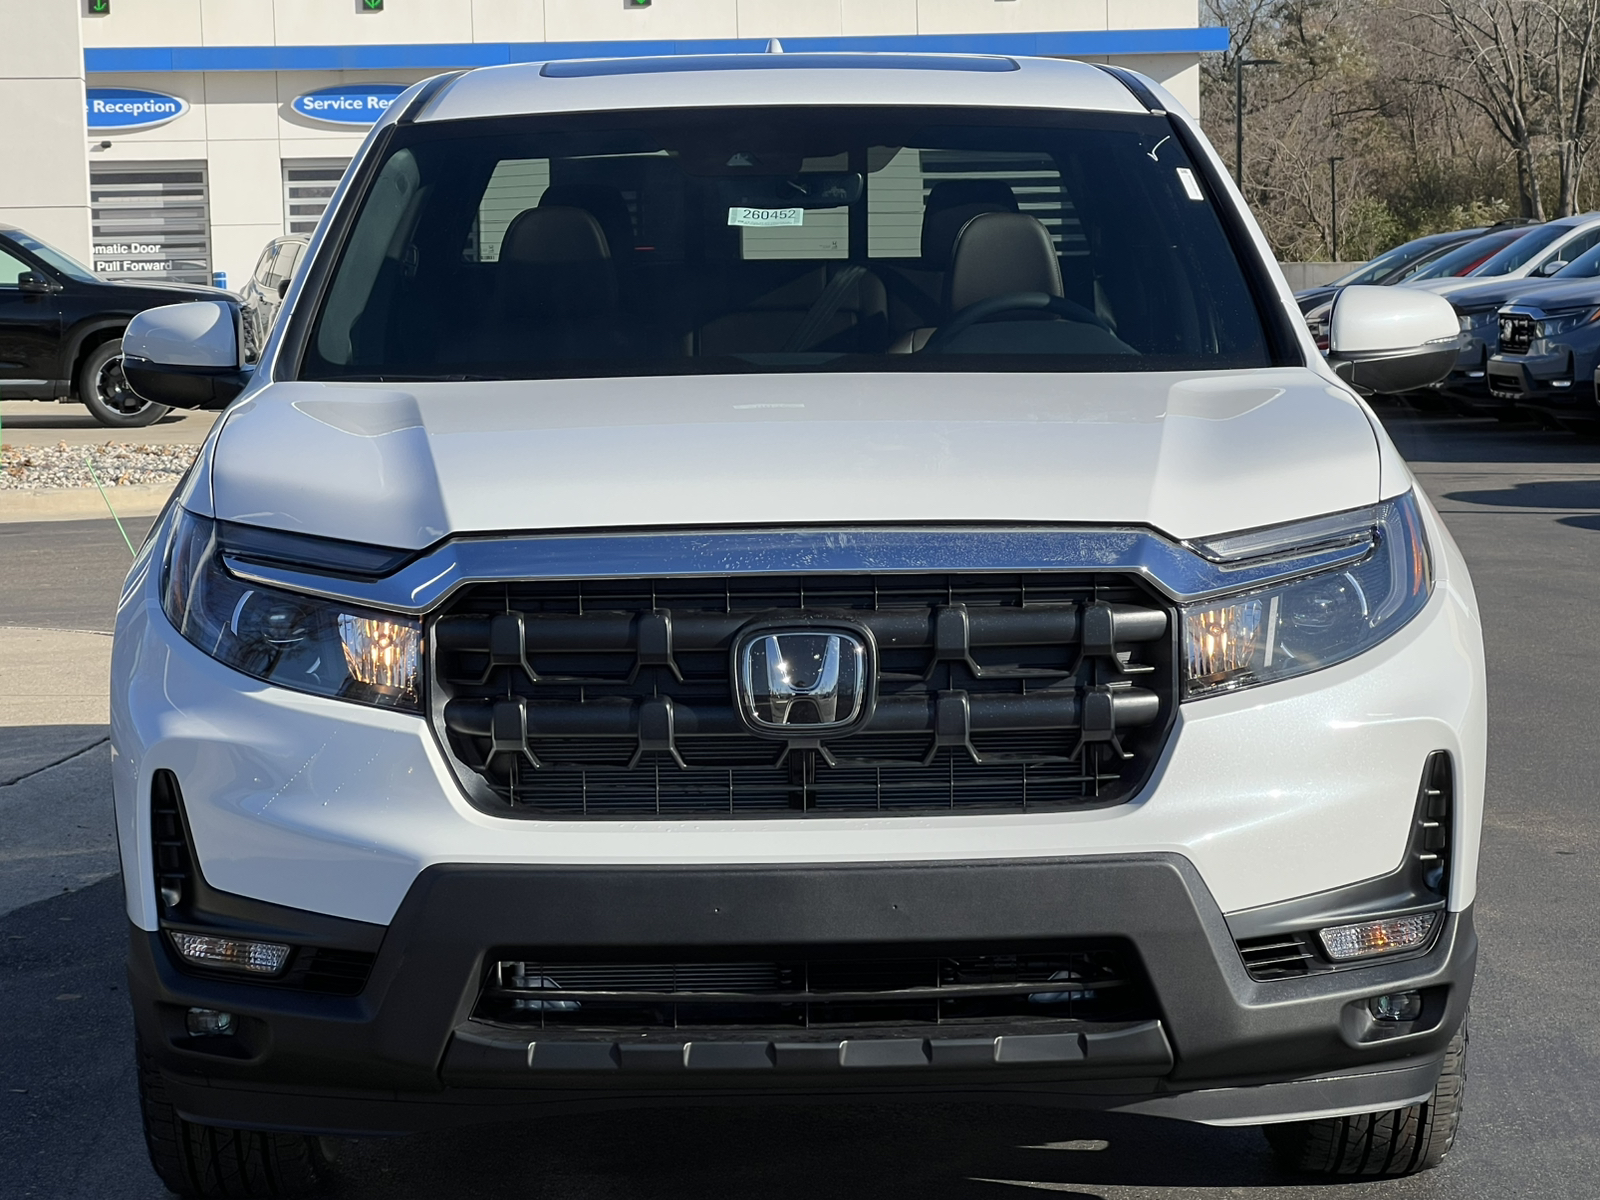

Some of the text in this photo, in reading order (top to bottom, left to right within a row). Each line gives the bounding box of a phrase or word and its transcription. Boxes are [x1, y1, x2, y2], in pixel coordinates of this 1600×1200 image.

[93, 100, 176, 116] Reception
[303, 96, 363, 110] Service
[743, 209, 796, 220] 260452
[131, 243, 161, 253] Door
[97, 260, 172, 271] Pull Forward
